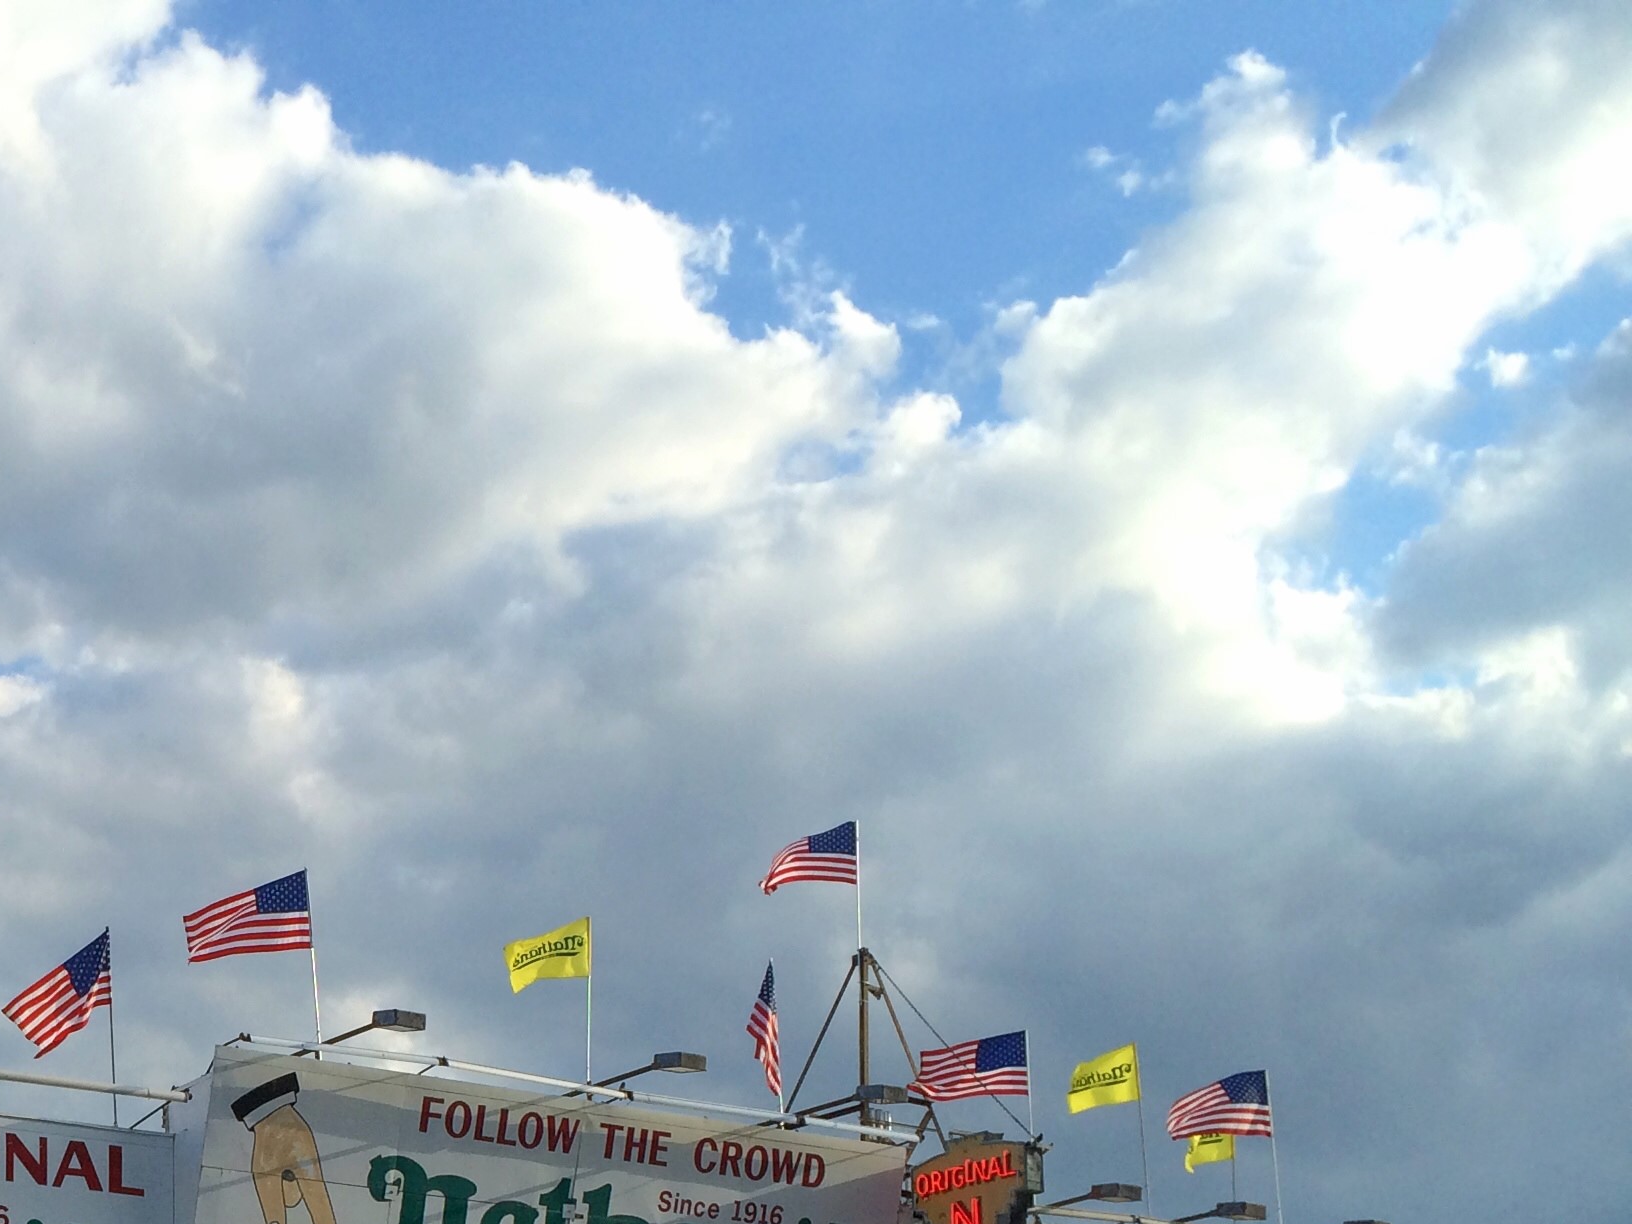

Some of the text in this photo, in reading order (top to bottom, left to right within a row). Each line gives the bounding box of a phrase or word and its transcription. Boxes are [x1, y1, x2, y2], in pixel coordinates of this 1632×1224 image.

[419, 1096, 826, 1188] FOLLOW THE CROWD
[916, 1149, 1017, 1200] ORIGINAL
[657, 1189, 720, 1222] Since
